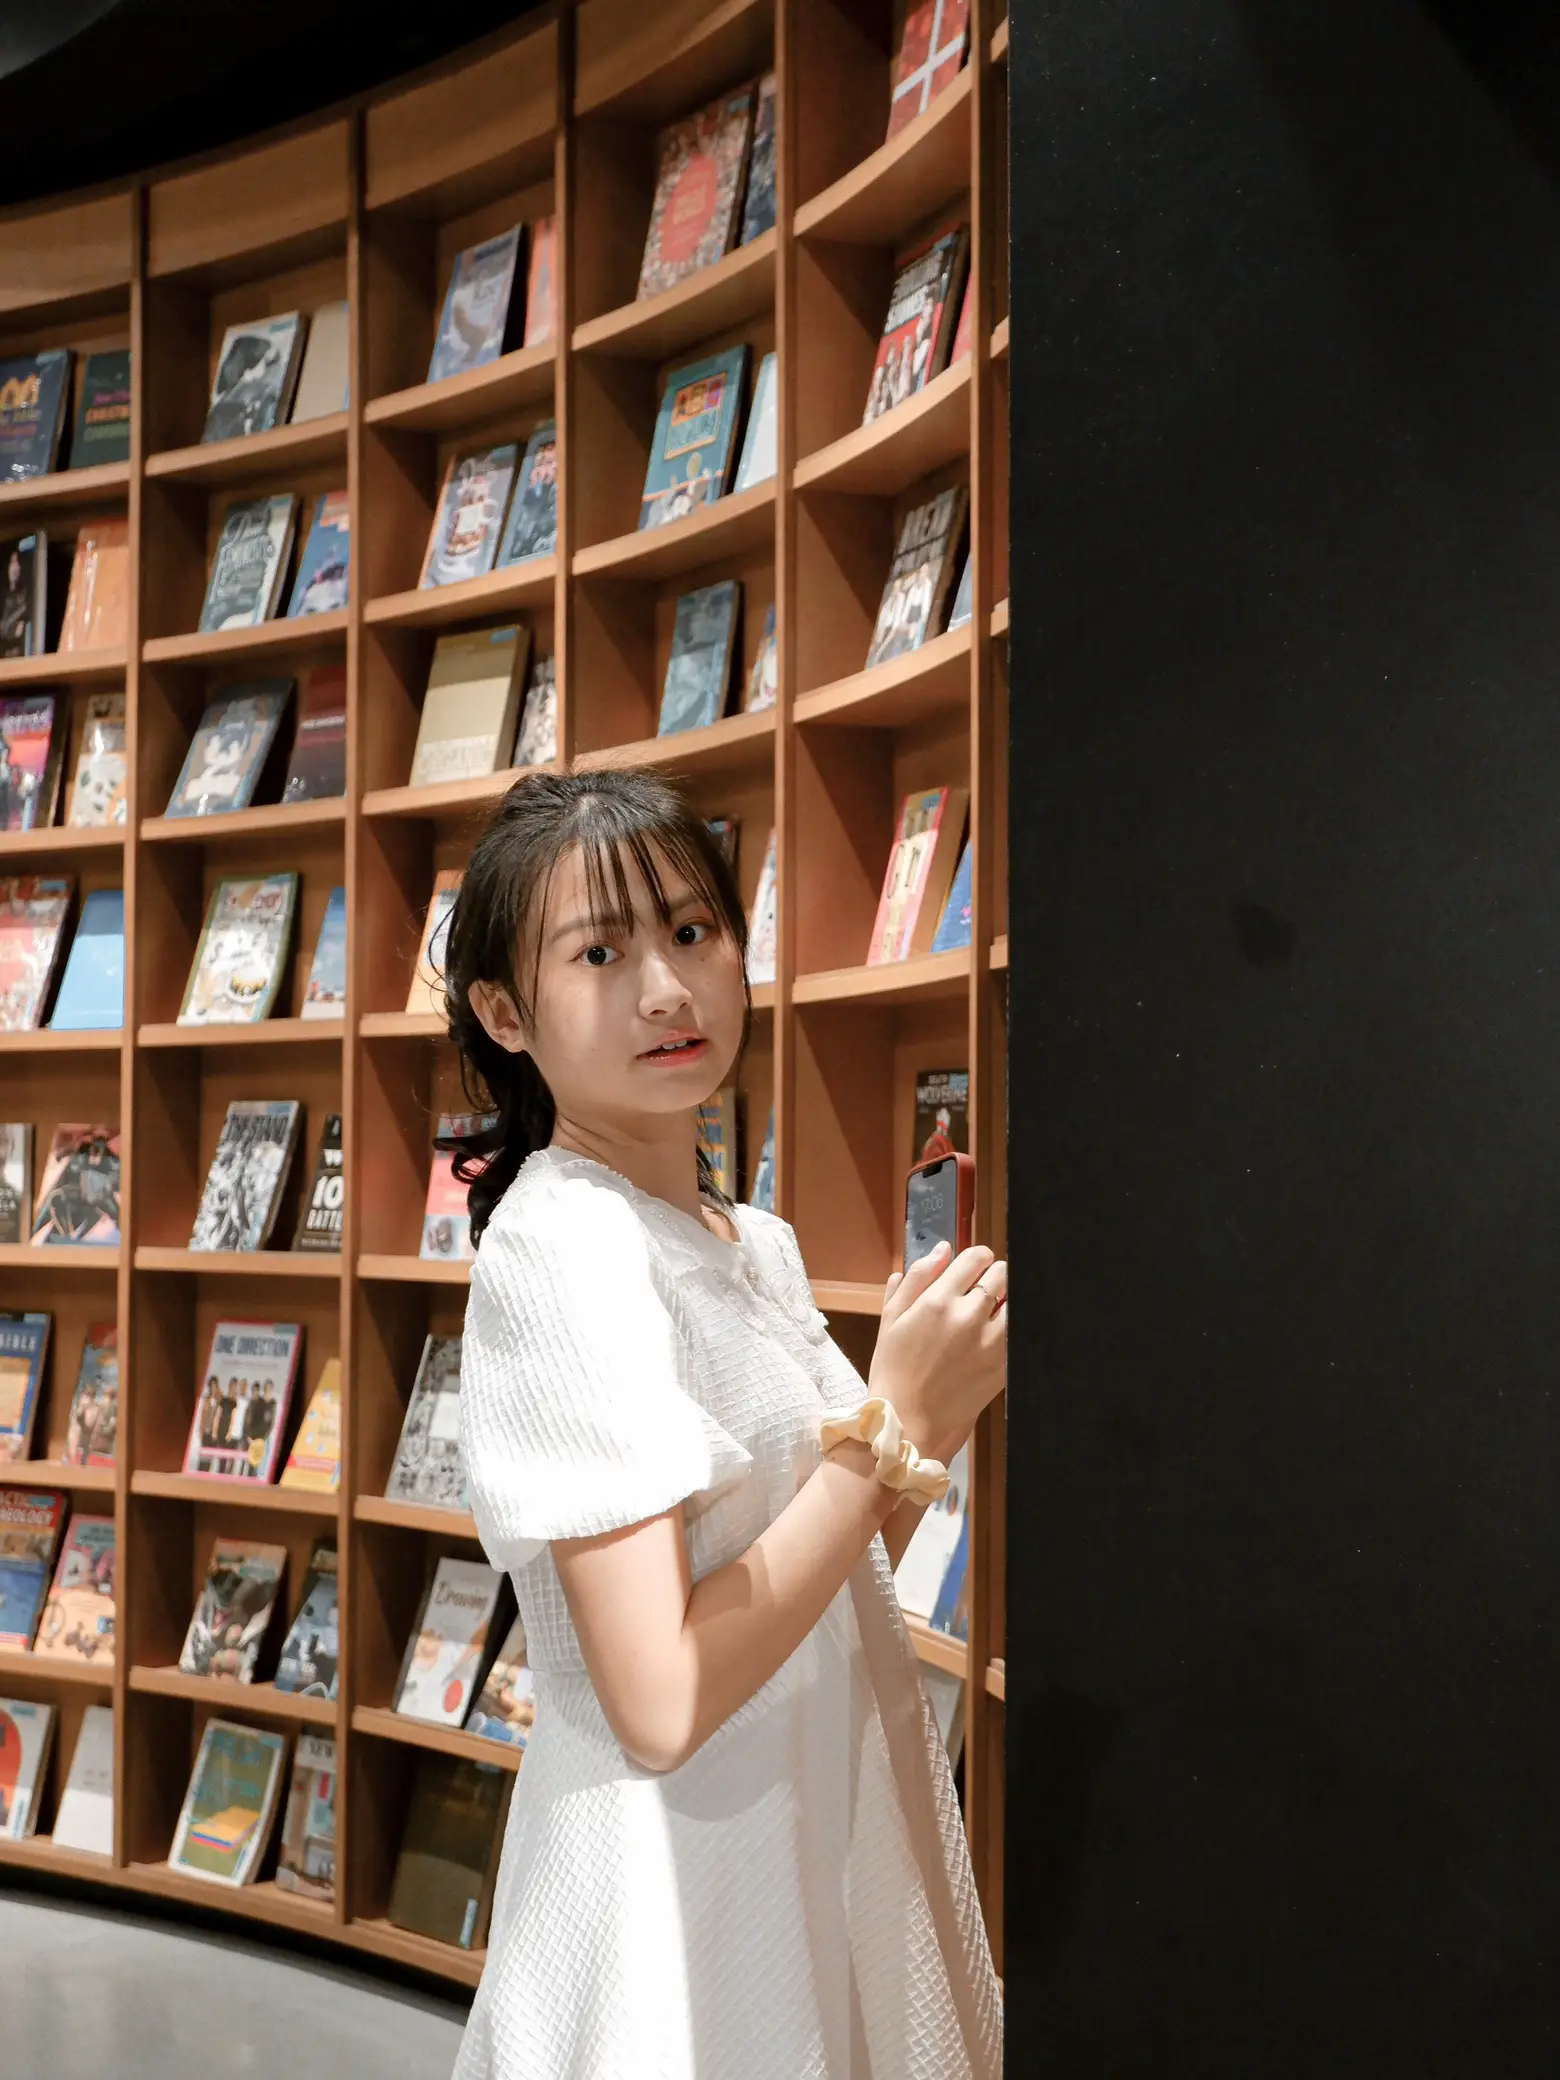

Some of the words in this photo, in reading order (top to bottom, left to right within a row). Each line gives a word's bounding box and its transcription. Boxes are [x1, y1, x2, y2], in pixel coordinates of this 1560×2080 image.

[215, 1334, 237, 1354] ONE
[237, 1336, 289, 1357] DIRECTION
[434, 1580, 488, 1620] Drawing
